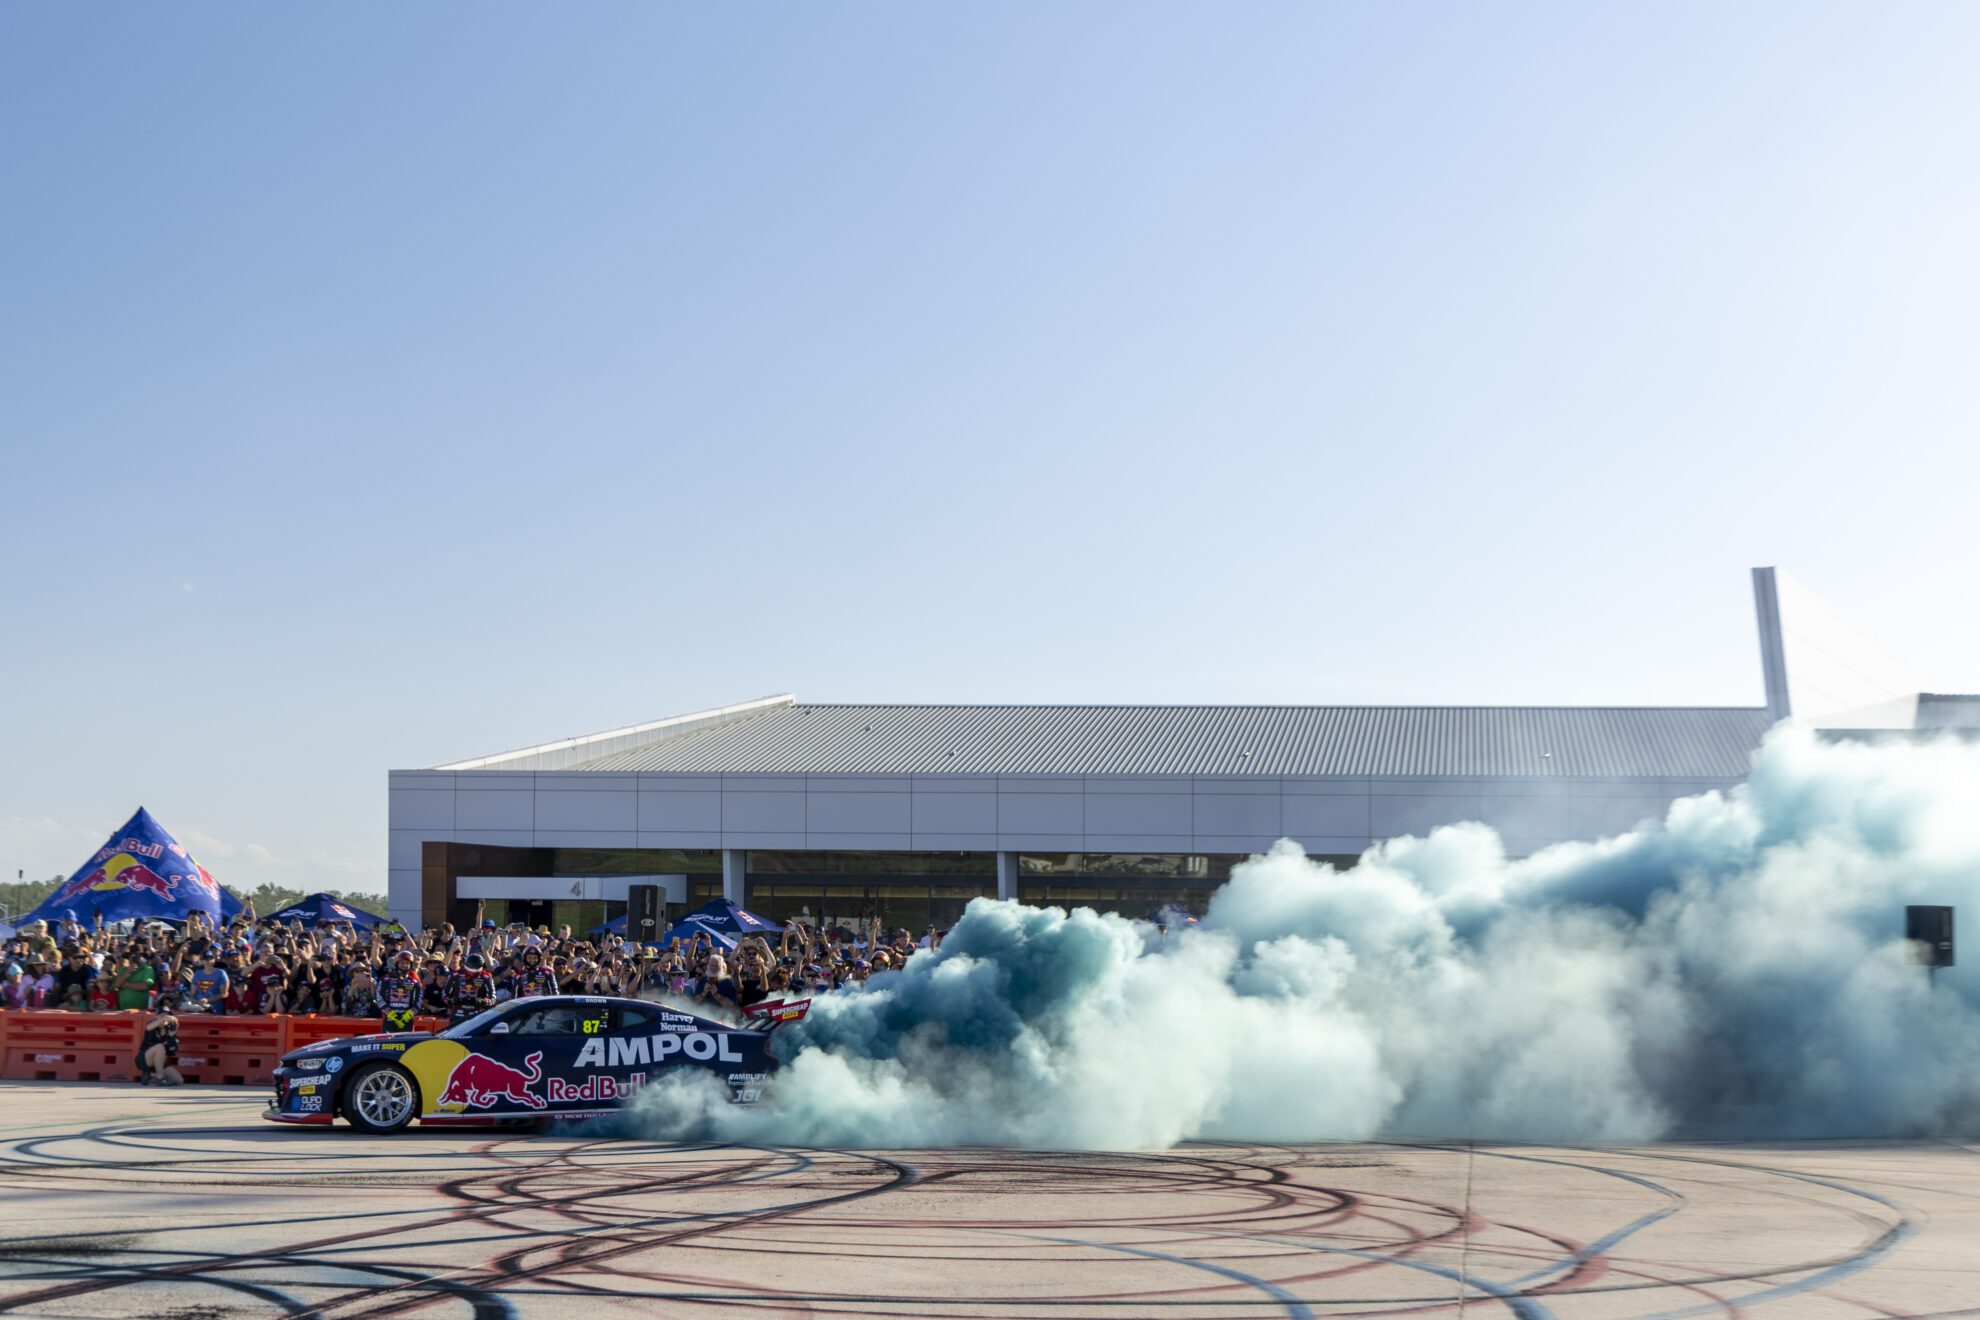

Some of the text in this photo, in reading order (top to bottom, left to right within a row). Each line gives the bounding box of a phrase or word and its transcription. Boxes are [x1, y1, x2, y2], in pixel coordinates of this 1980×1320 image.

[123, 837, 164, 858] Bull
[570, 881, 581, 896] 4
[772, 1003, 808, 1016] SUPERCHEAP
[661, 1012, 694, 1023] Harvey
[583, 1020, 600, 1034] 87
[660, 1022, 698, 1031] Norman
[351, 1045, 372, 1053] MAKE
[381, 1043, 406, 1051] SUPER
[573, 1033, 743, 1068] AMPOL
[289, 1074, 332, 1088] SUPERCHEAP
[548, 1072, 646, 1101] Red Bull
